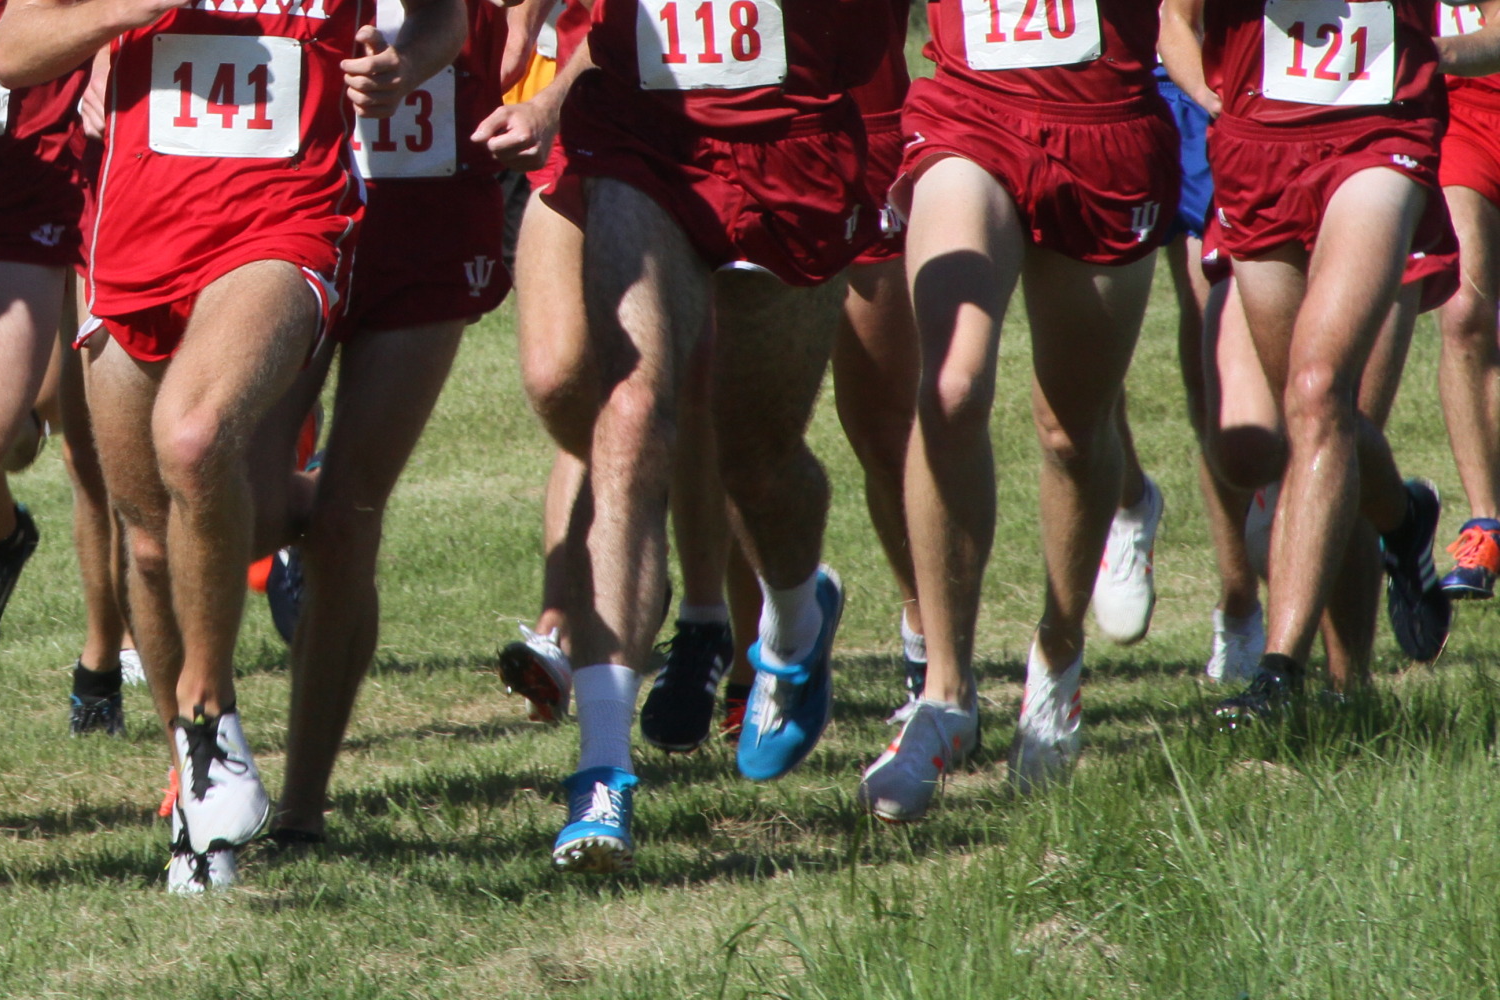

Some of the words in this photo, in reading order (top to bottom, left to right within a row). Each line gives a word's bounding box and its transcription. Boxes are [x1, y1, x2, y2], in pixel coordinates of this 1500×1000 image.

[659, 0, 762, 64] 118
[1285, 21, 1370, 82] 121
[173, 61, 273, 129] 141
